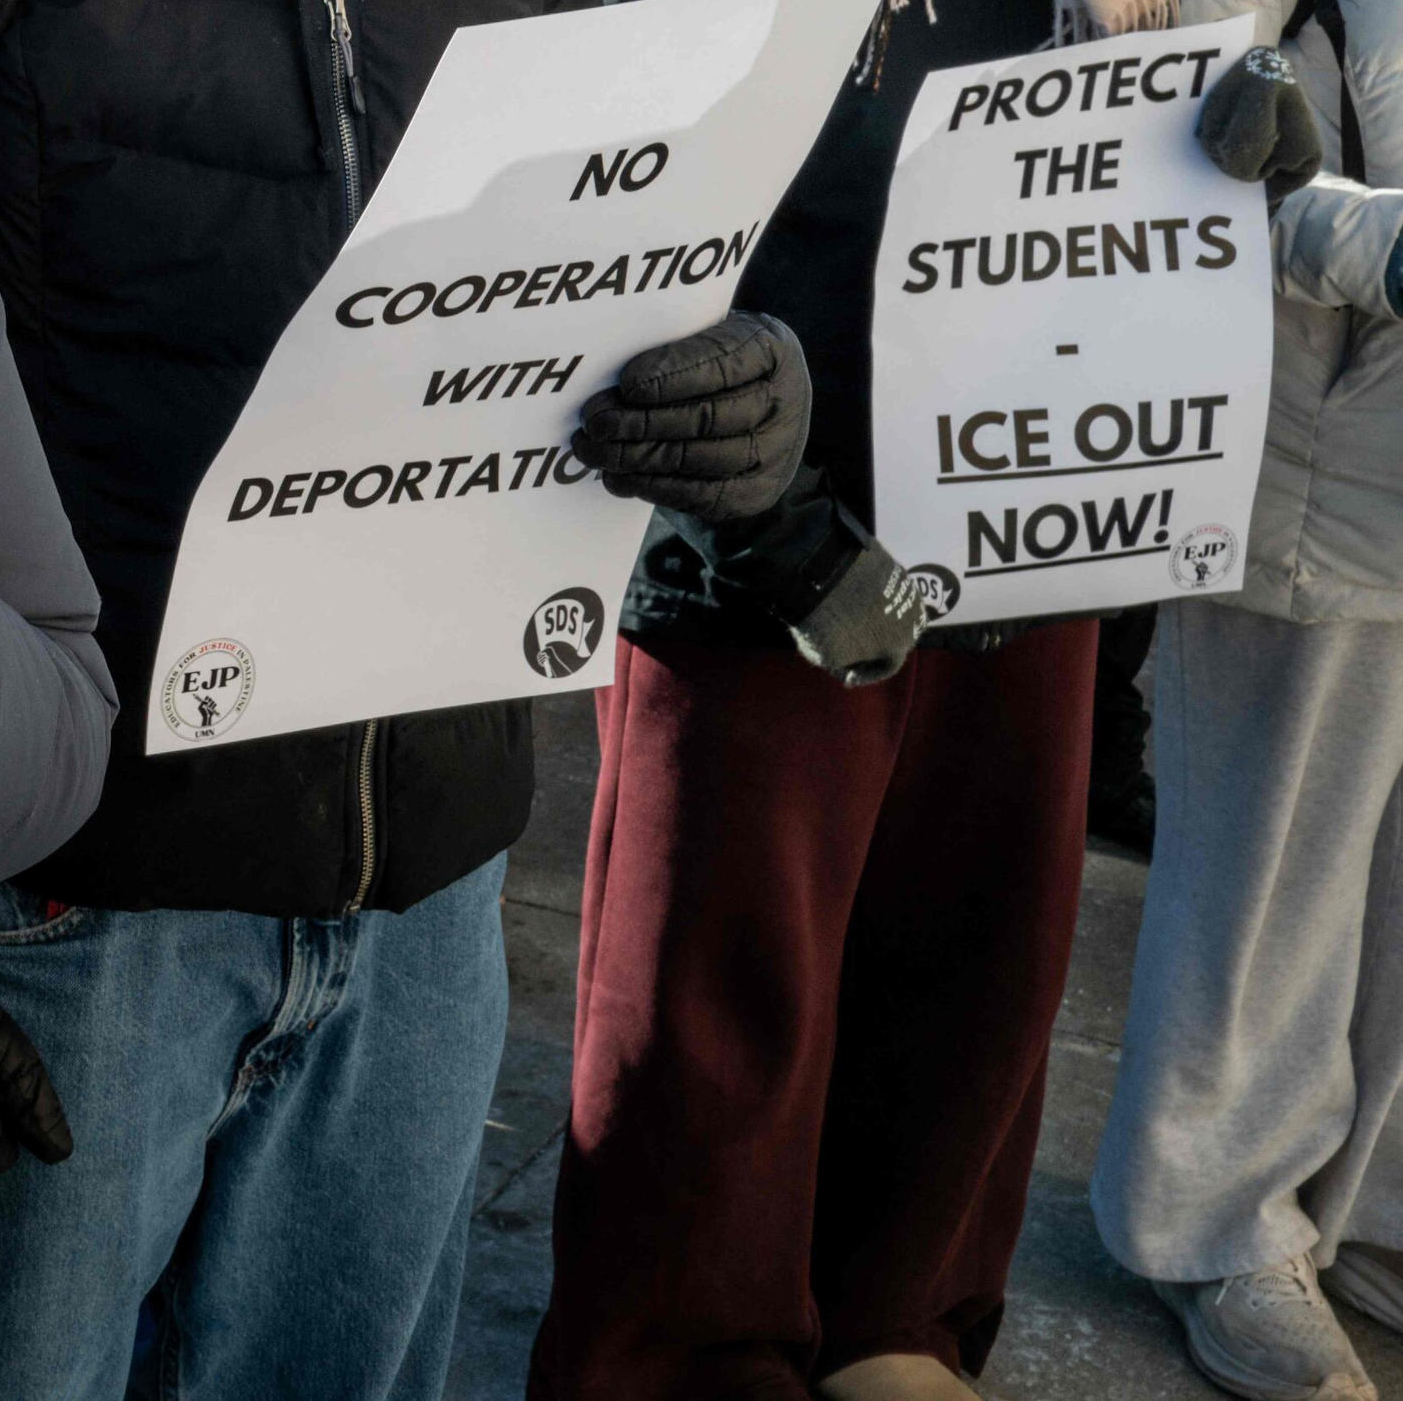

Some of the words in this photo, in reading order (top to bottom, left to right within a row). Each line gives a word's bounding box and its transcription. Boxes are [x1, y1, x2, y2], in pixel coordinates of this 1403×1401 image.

[948, 48, 1221, 132] PROTECT
[569, 142, 669, 202] NO
[1014, 139, 1123, 199] THE
[335, 221, 760, 329] COOPERATION
[902, 215, 1237, 294] STUDENTS
[422, 354, 584, 407] WITH
[937, 408, 1052, 474] ICE
[1074, 394, 1229, 463] OUT
[227, 445, 603, 522] DEPORTATIO
[967, 488, 1174, 568] NOW!
[1183, 542, 1226, 561] EJP
[544, 604, 579, 636] SDS
[181, 666, 240, 694] EJP
[194, 729, 215, 738] UMN
